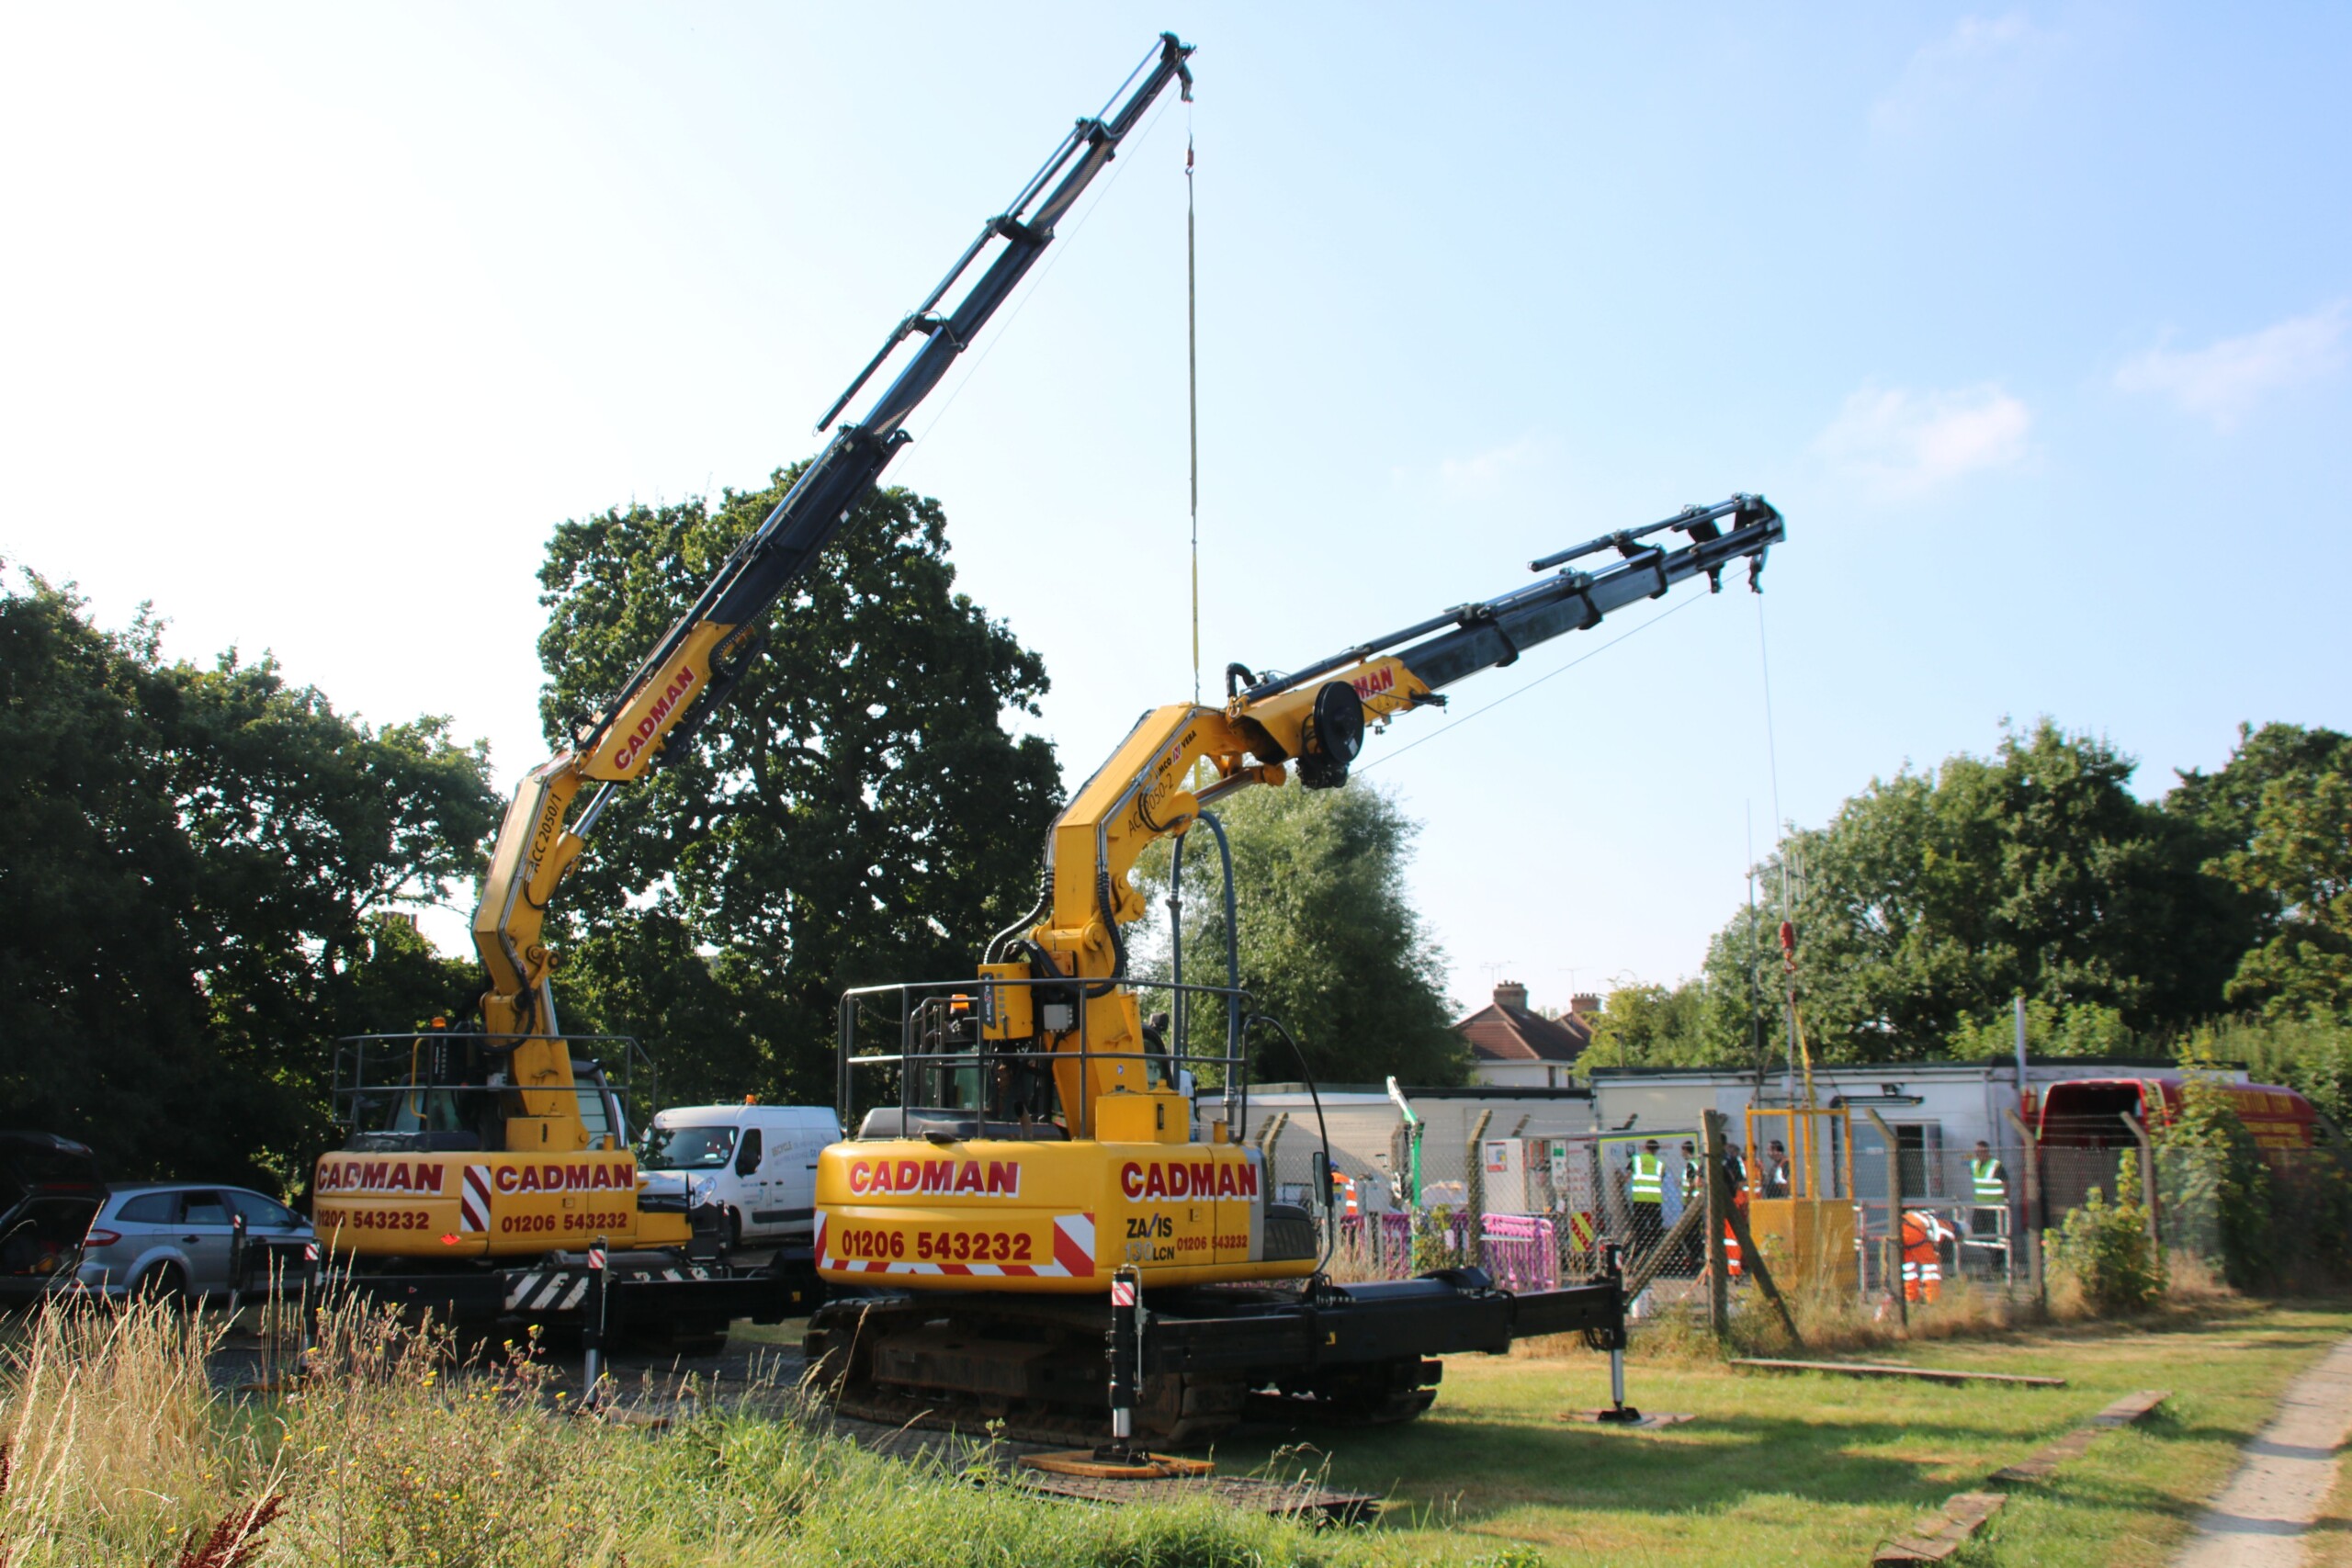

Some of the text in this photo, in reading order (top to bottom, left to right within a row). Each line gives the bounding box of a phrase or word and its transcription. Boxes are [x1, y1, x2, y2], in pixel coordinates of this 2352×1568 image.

[1353, 665, 1395, 703] MAN
[615, 665, 696, 770] CADMAN
[1182, 730, 1197, 749] VEBA
[538, 793, 562, 843] 2050/1
[318, 1162, 444, 1195] CADMAN
[495, 1164, 635, 1194] CADMAN
[849, 1160, 1021, 1198] CADMAN
[1121, 1162, 1260, 1201] CADMAN
[353, 1211, 430, 1230] 543232
[501, 1213, 628, 1233] 01206 543232
[842, 1229, 1032, 1260] 01206 543232
[1177, 1235, 1248, 1251] 01206 543232
